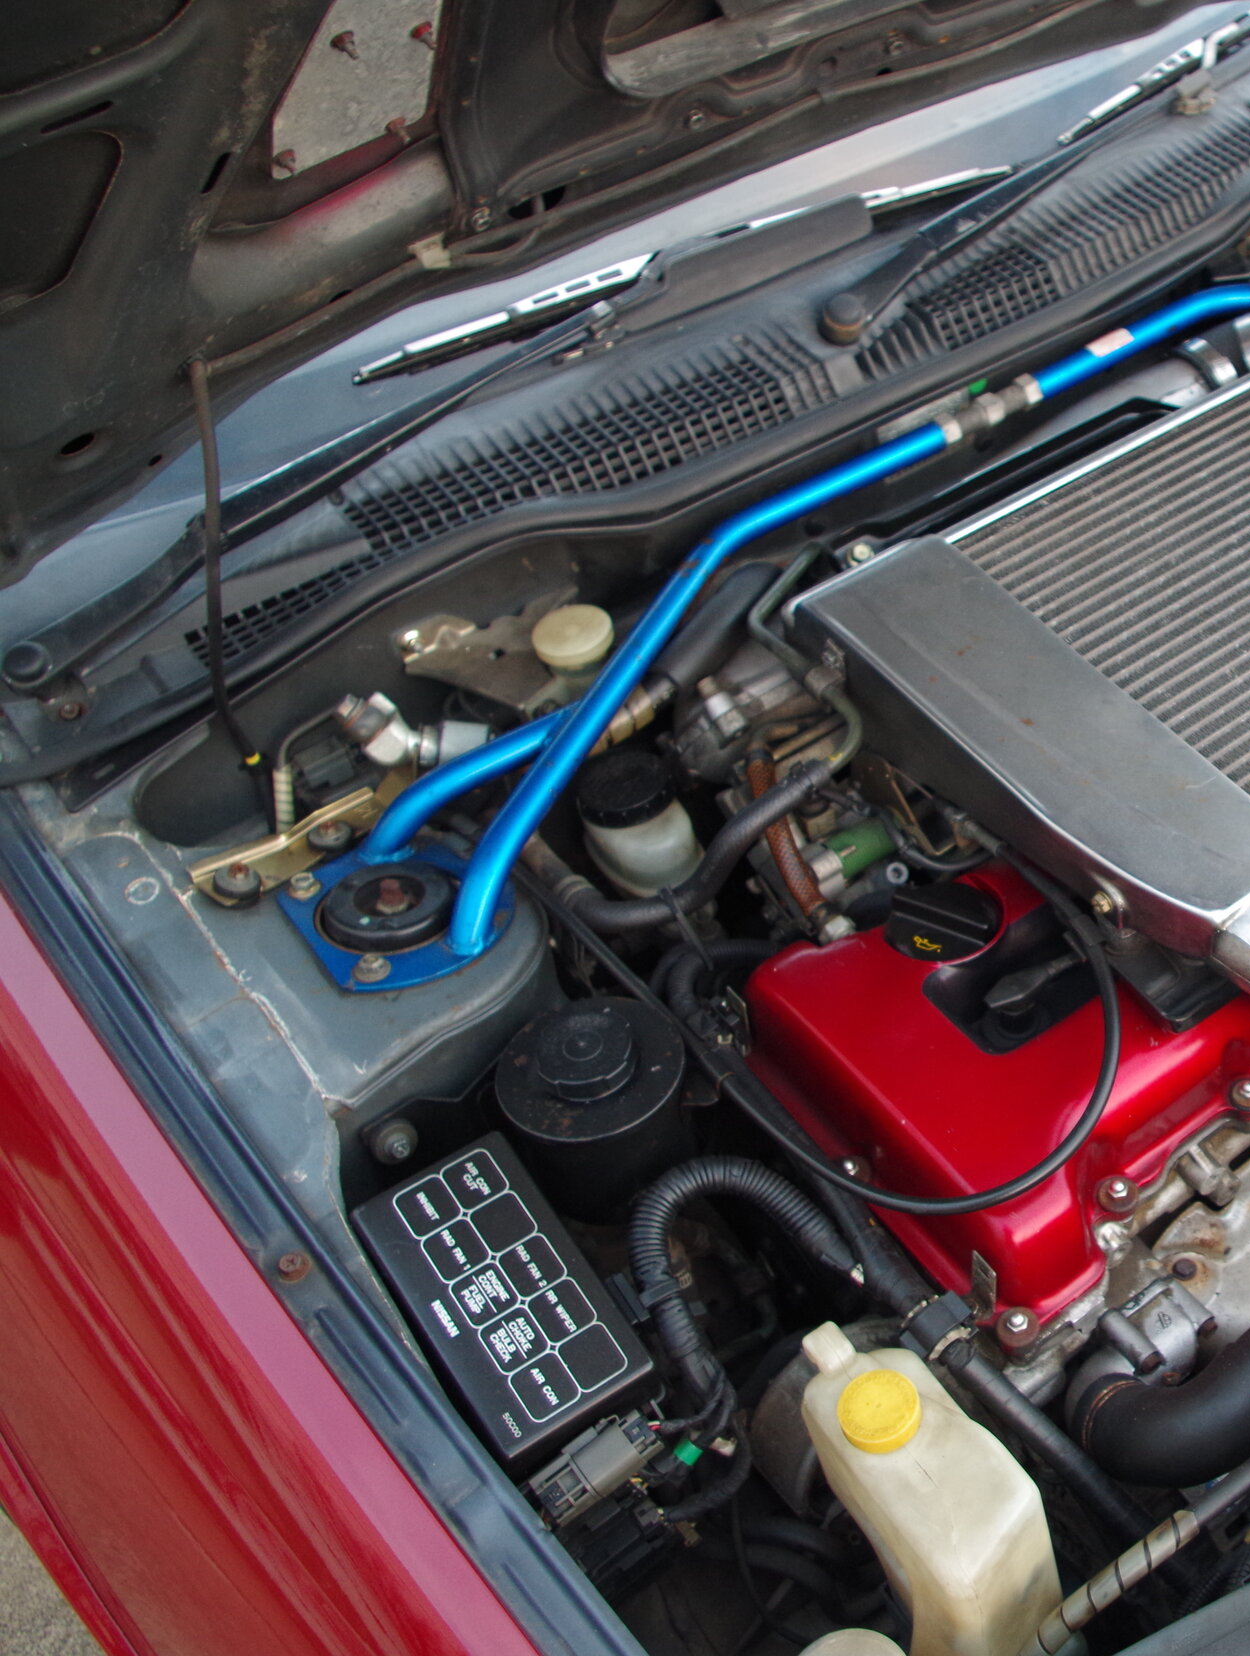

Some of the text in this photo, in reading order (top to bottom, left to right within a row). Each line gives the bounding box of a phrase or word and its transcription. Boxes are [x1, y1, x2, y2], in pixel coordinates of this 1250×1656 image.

[463, 1173, 478, 1191] CUT
[465, 1162, 491, 1195] AIR CON
[416, 1192, 440, 1221] INHIBIT
[440, 1229, 471, 1271] RAD FAN 1
[515, 1245, 548, 1288] RAD FAN 2
[468, 1284, 486, 1309] FUEL
[478, 1271, 497, 1298] CONT
[485, 1270, 510, 1302] ENGINE
[460, 1287, 481, 1314] PUMP
[545, 1290, 577, 1333] RR WIPER
[431, 1299, 460, 1338] NISSAN
[516, 1317, 535, 1341] AUTO
[490, 1333, 512, 1363] CHECK
[497, 1328, 516, 1353] BULB
[508, 1321, 532, 1353] CHOKE
[530, 1367, 559, 1405] AIR CON
